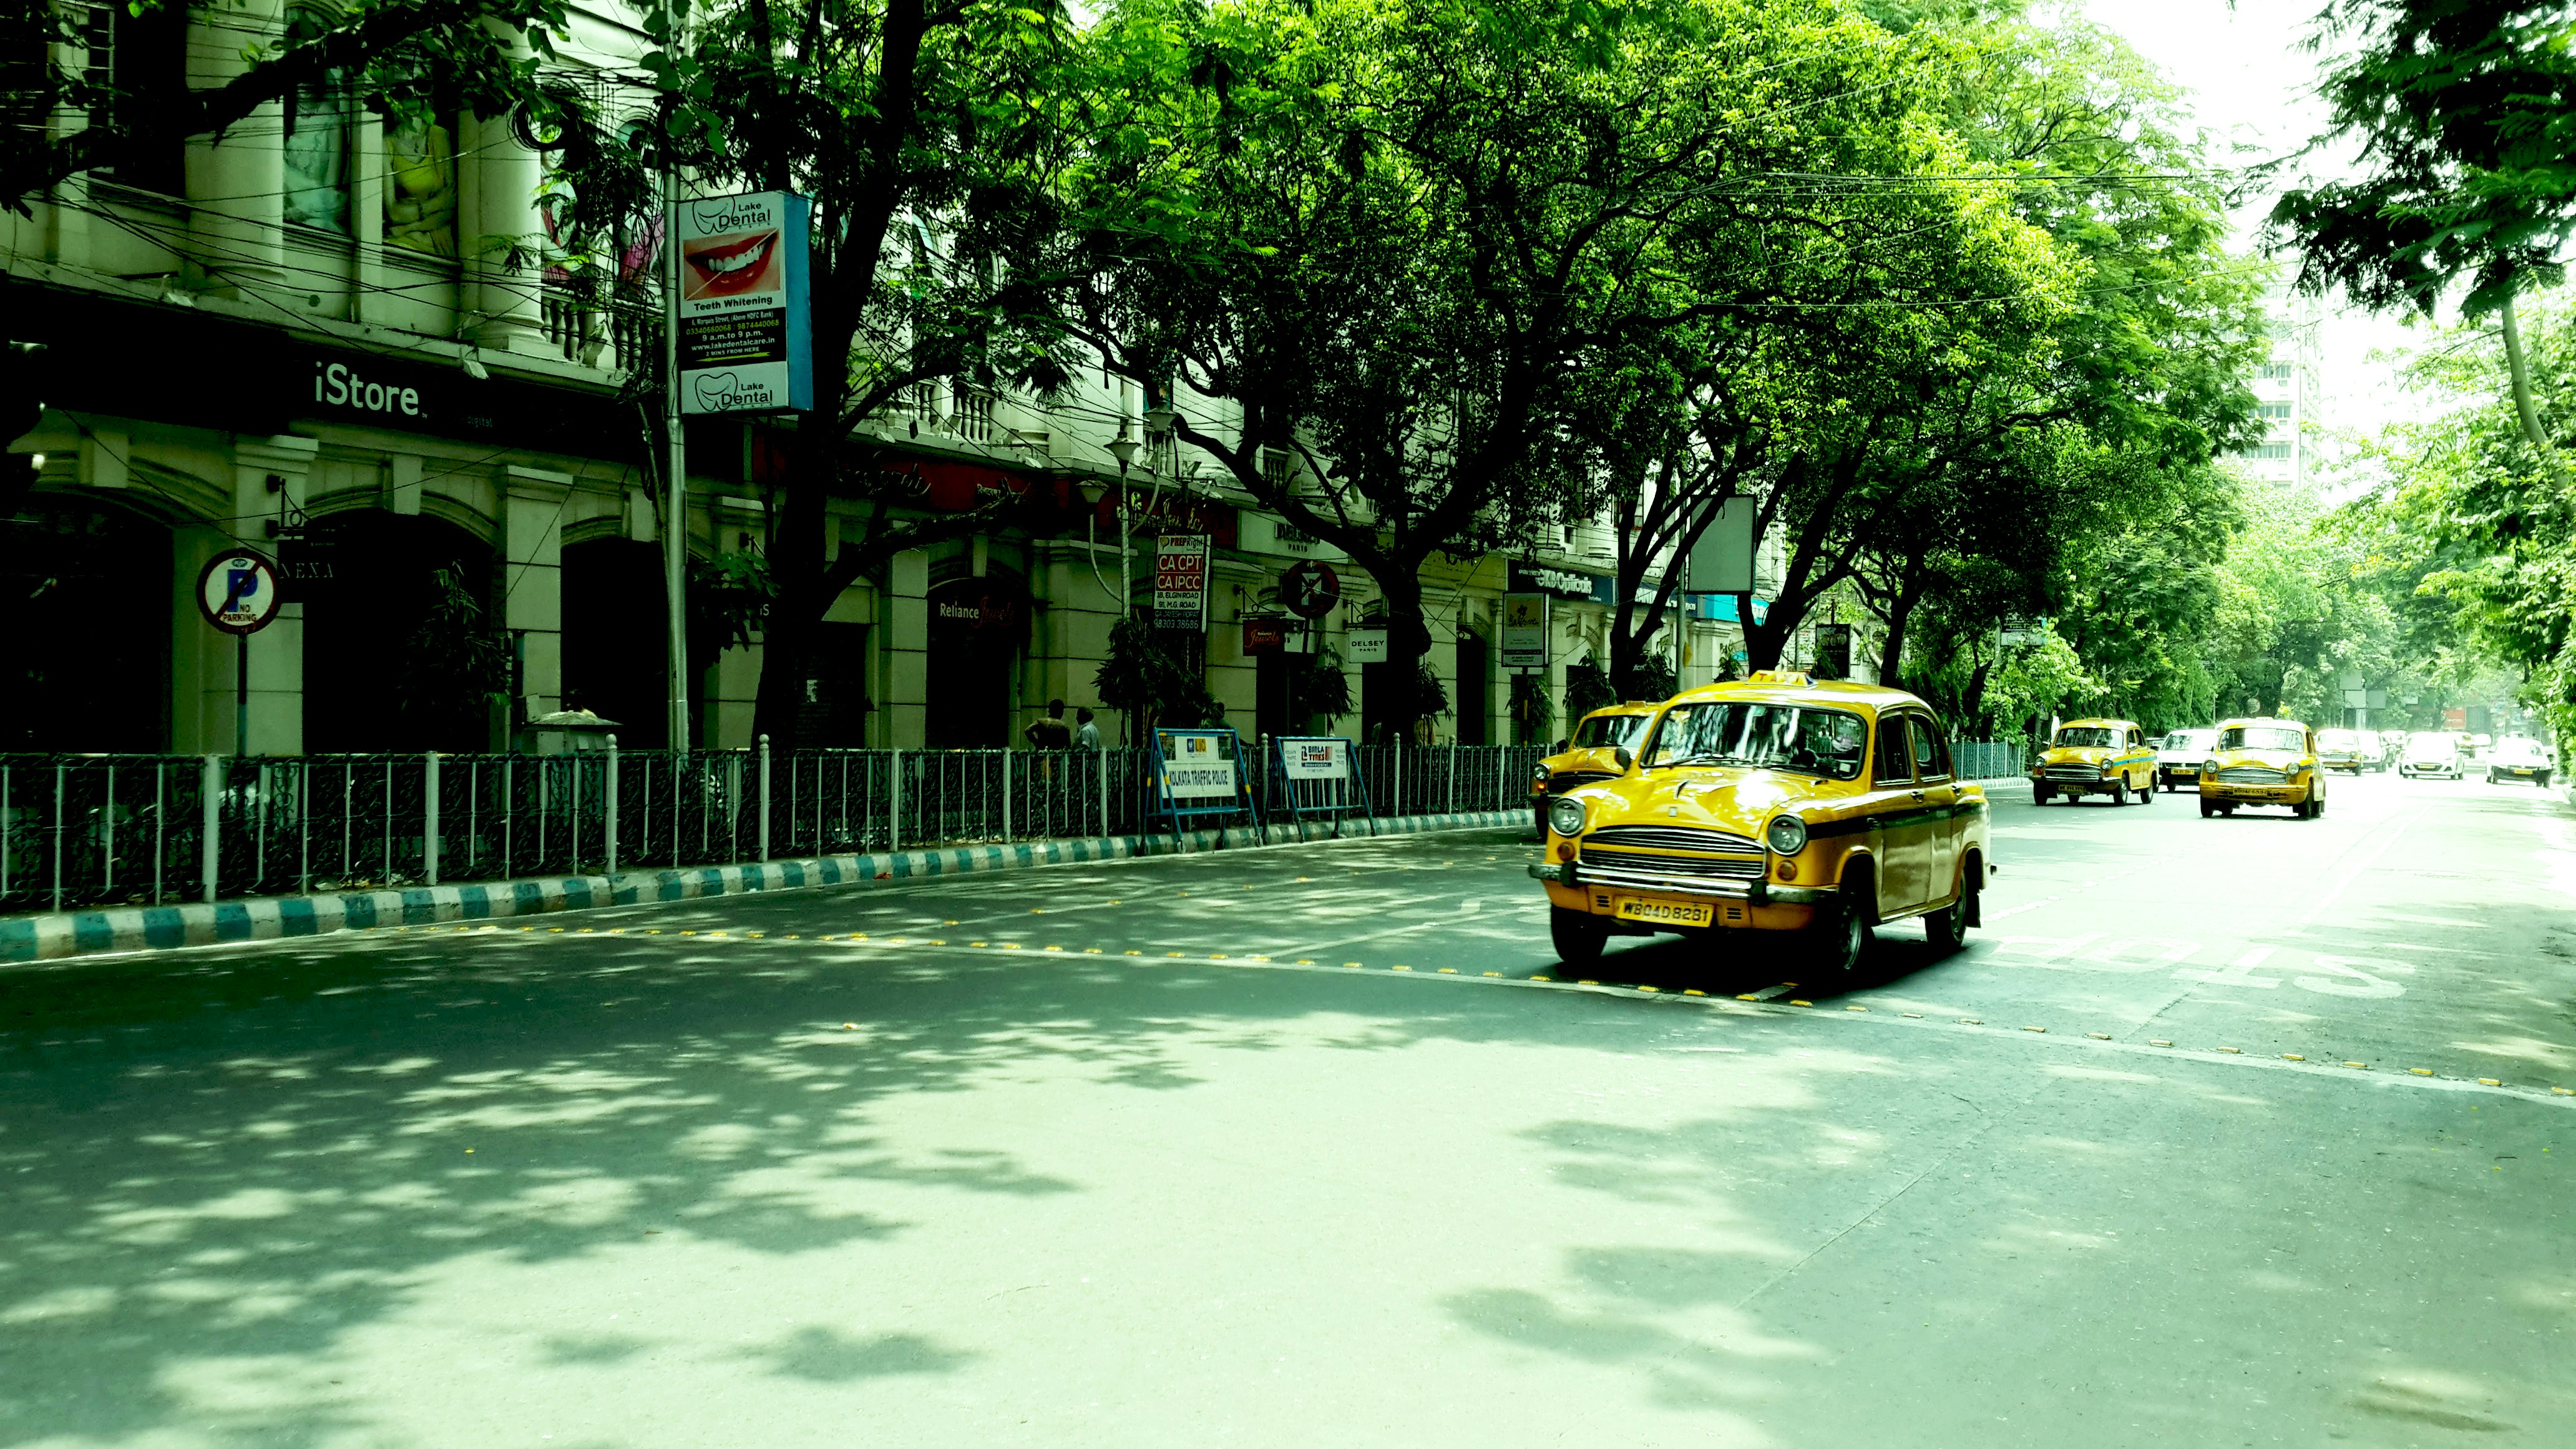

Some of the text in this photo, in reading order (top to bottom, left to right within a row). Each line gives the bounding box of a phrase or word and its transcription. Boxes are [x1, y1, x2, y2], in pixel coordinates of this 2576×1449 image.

[738, 202, 762, 212] Lake
[719, 208, 771, 227] Dental
[694, 296, 773, 311] Teeth Whitening
[745, 330, 763, 339] p.m.
[691, 336, 775, 351] www.lakedentalcare.in
[316, 361, 419, 416] iStore
[741, 383, 764, 391] Lake
[721, 389, 773, 406] Dental
[1159, 555, 1202, 571] CA CPT
[1157, 575, 1201, 590] CA IPCC
[1556, 572, 1593, 595] Opticals
[240, 604, 251, 613] NO
[940, 600, 980, 619] Reliance
[223, 613, 257, 622] PARKING
[1169, 769, 1228, 786] KOLKATA TRAFFIC POLICE
